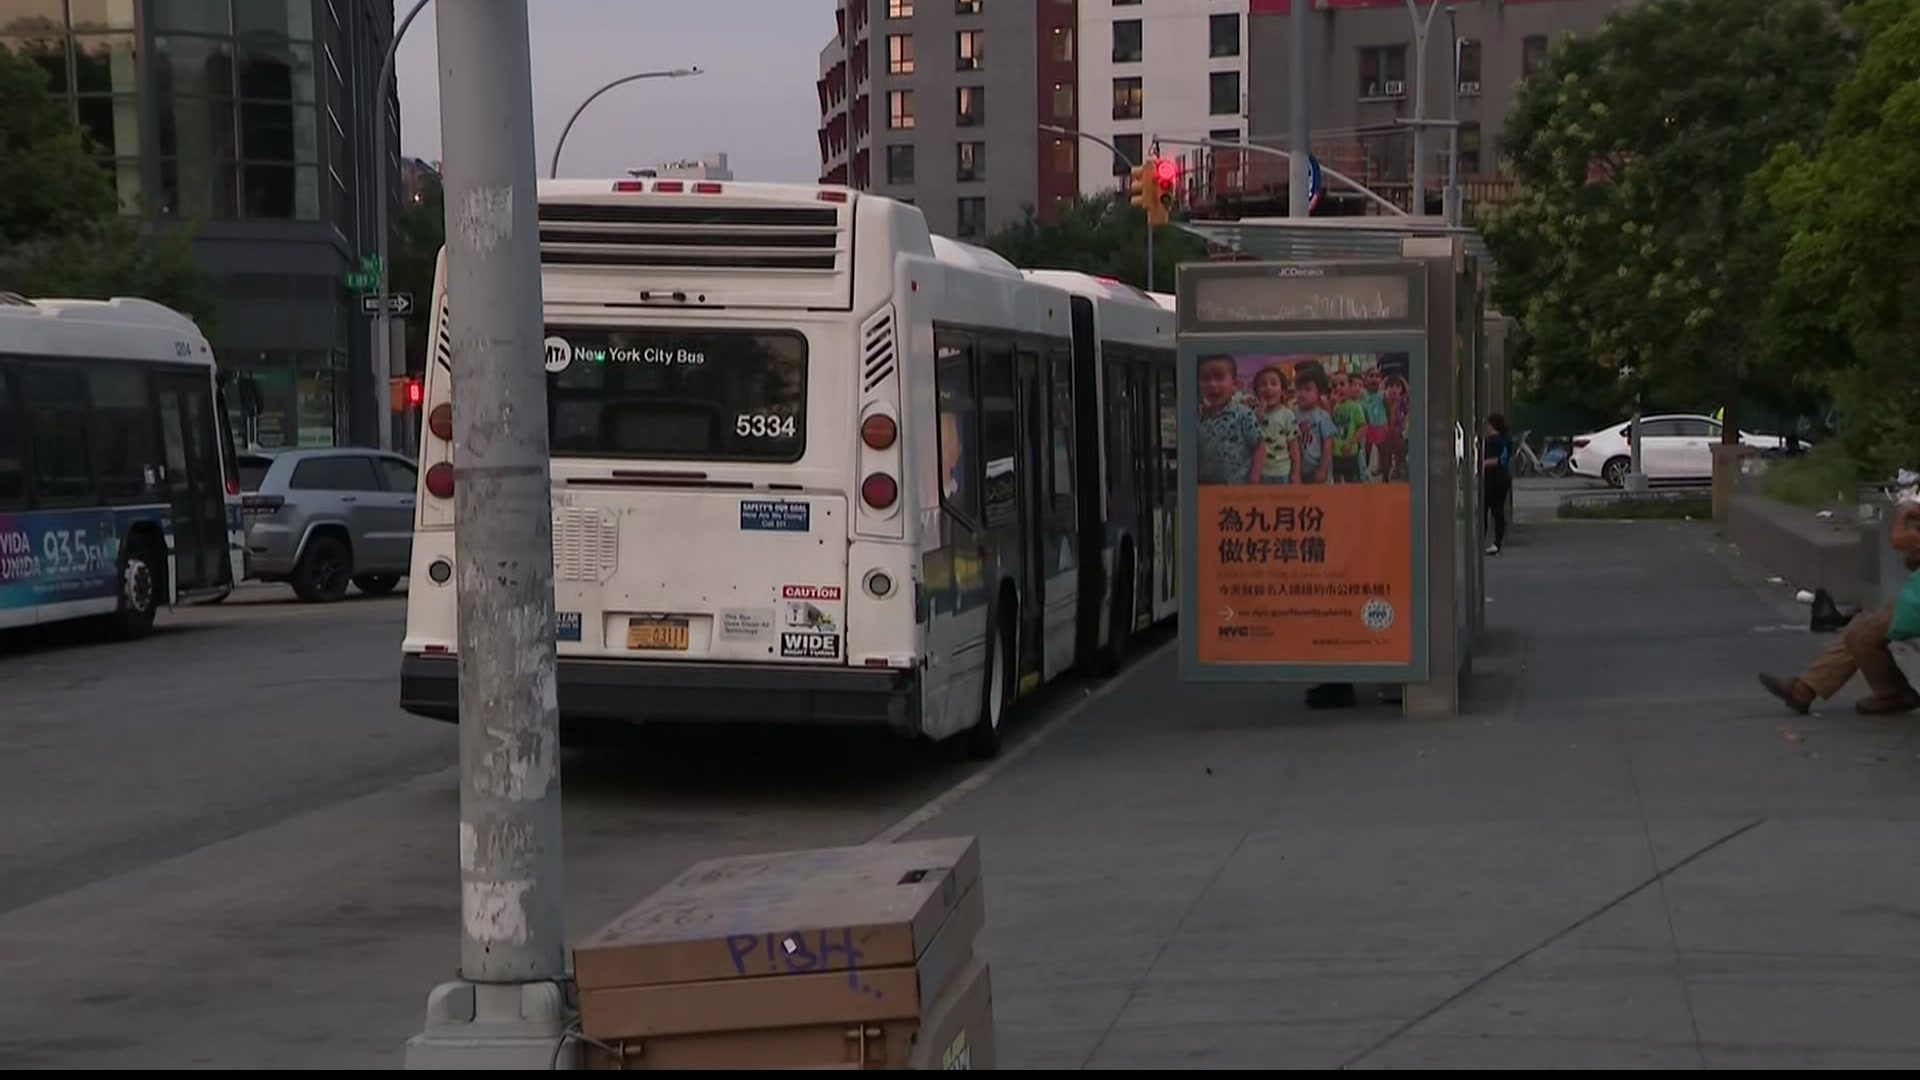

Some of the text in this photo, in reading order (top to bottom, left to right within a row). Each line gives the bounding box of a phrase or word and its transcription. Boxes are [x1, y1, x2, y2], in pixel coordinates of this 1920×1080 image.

[574, 346, 606, 362] New
[608, 346, 641, 362] York
[644, 347, 673, 366] City
[677, 349, 705, 364] Bus
[736, 414, 796, 438] 5334
[1218, 506, 1325, 533] 為九月份
[0, 531, 31, 554] VIDA
[1218, 536, 1326, 564] 做好準備
[1, 555, 42, 580] UNIDA
[785, 587, 838, 598] CAUTION
[784, 635, 835, 650] WIDE
